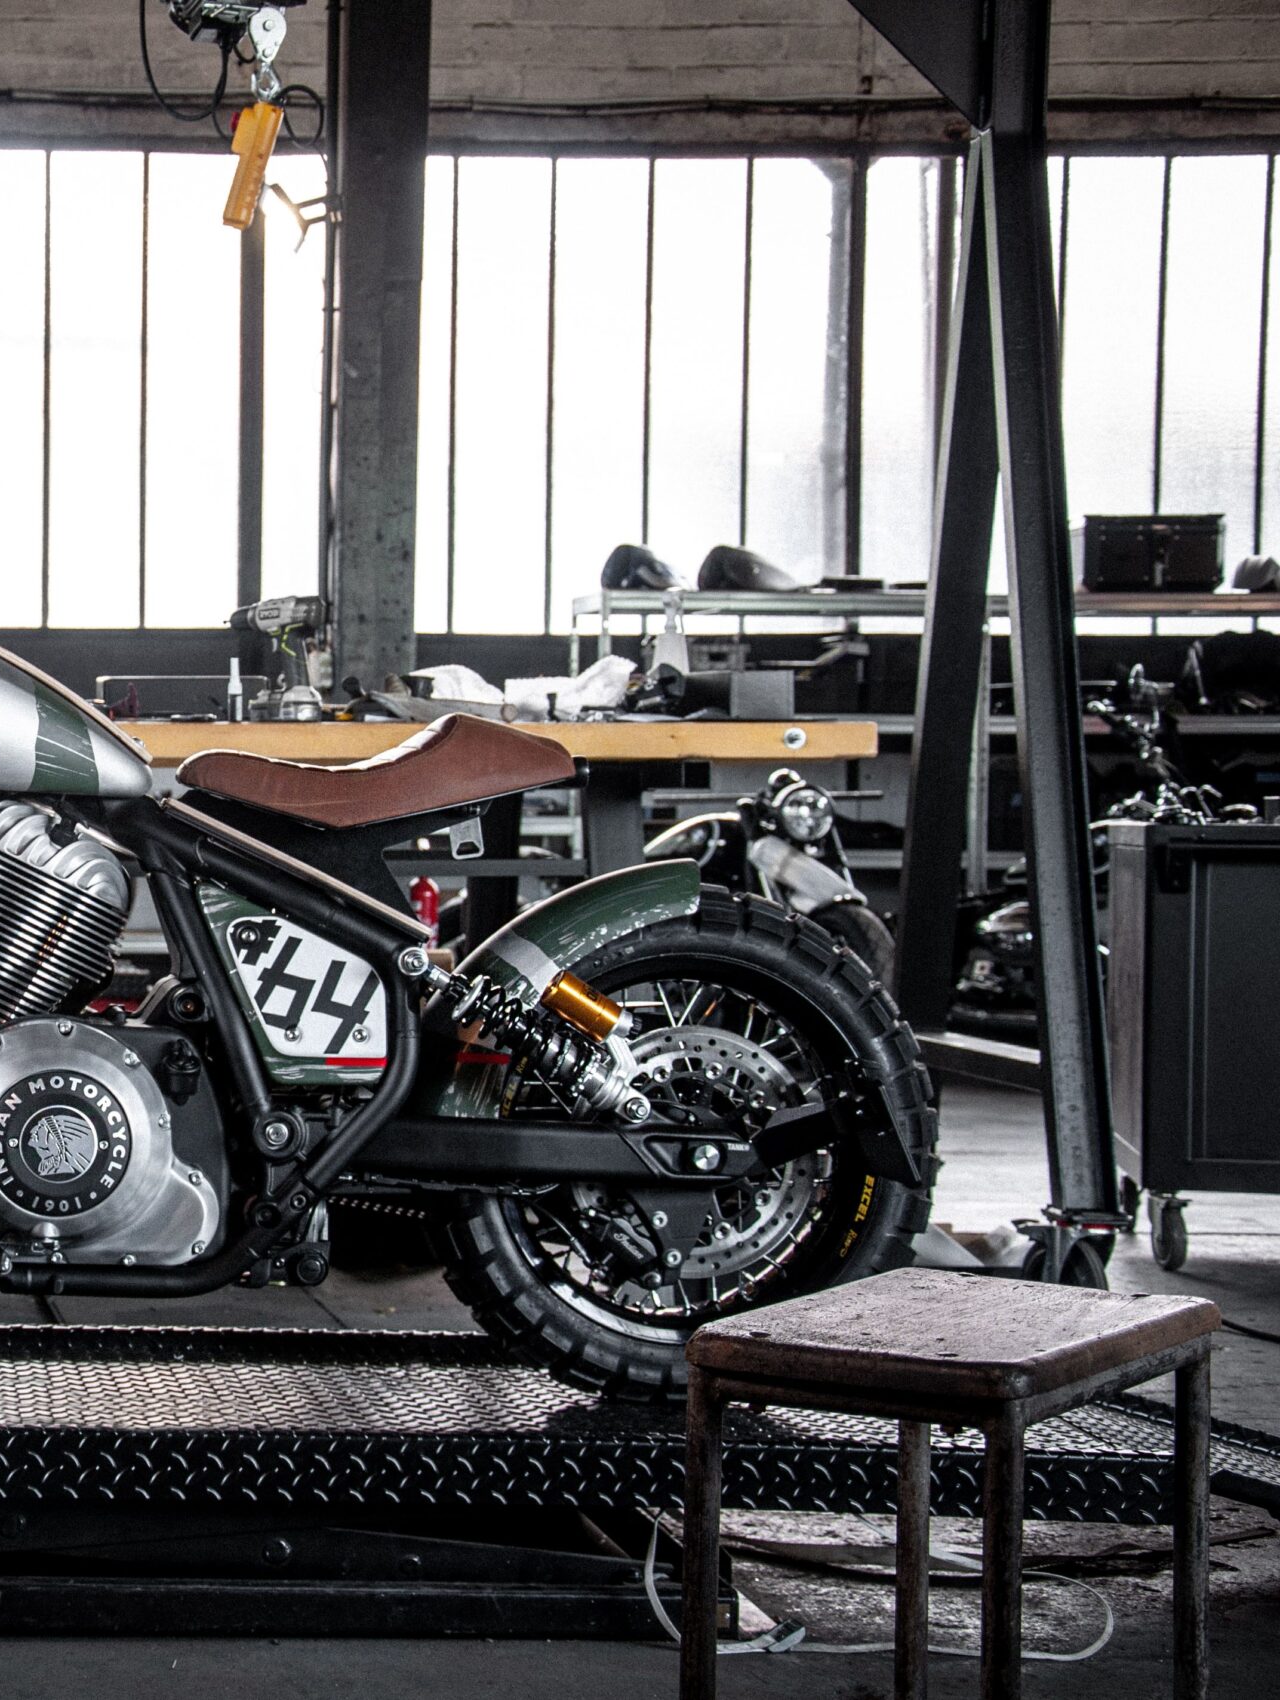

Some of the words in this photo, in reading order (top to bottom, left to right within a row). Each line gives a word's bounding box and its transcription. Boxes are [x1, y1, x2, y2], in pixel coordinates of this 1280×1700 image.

[28, 1075, 127, 1189] MOTORCYCLE
[32, 1196, 82, 1212] 1901
[854, 1174, 875, 1222] EXCEL
